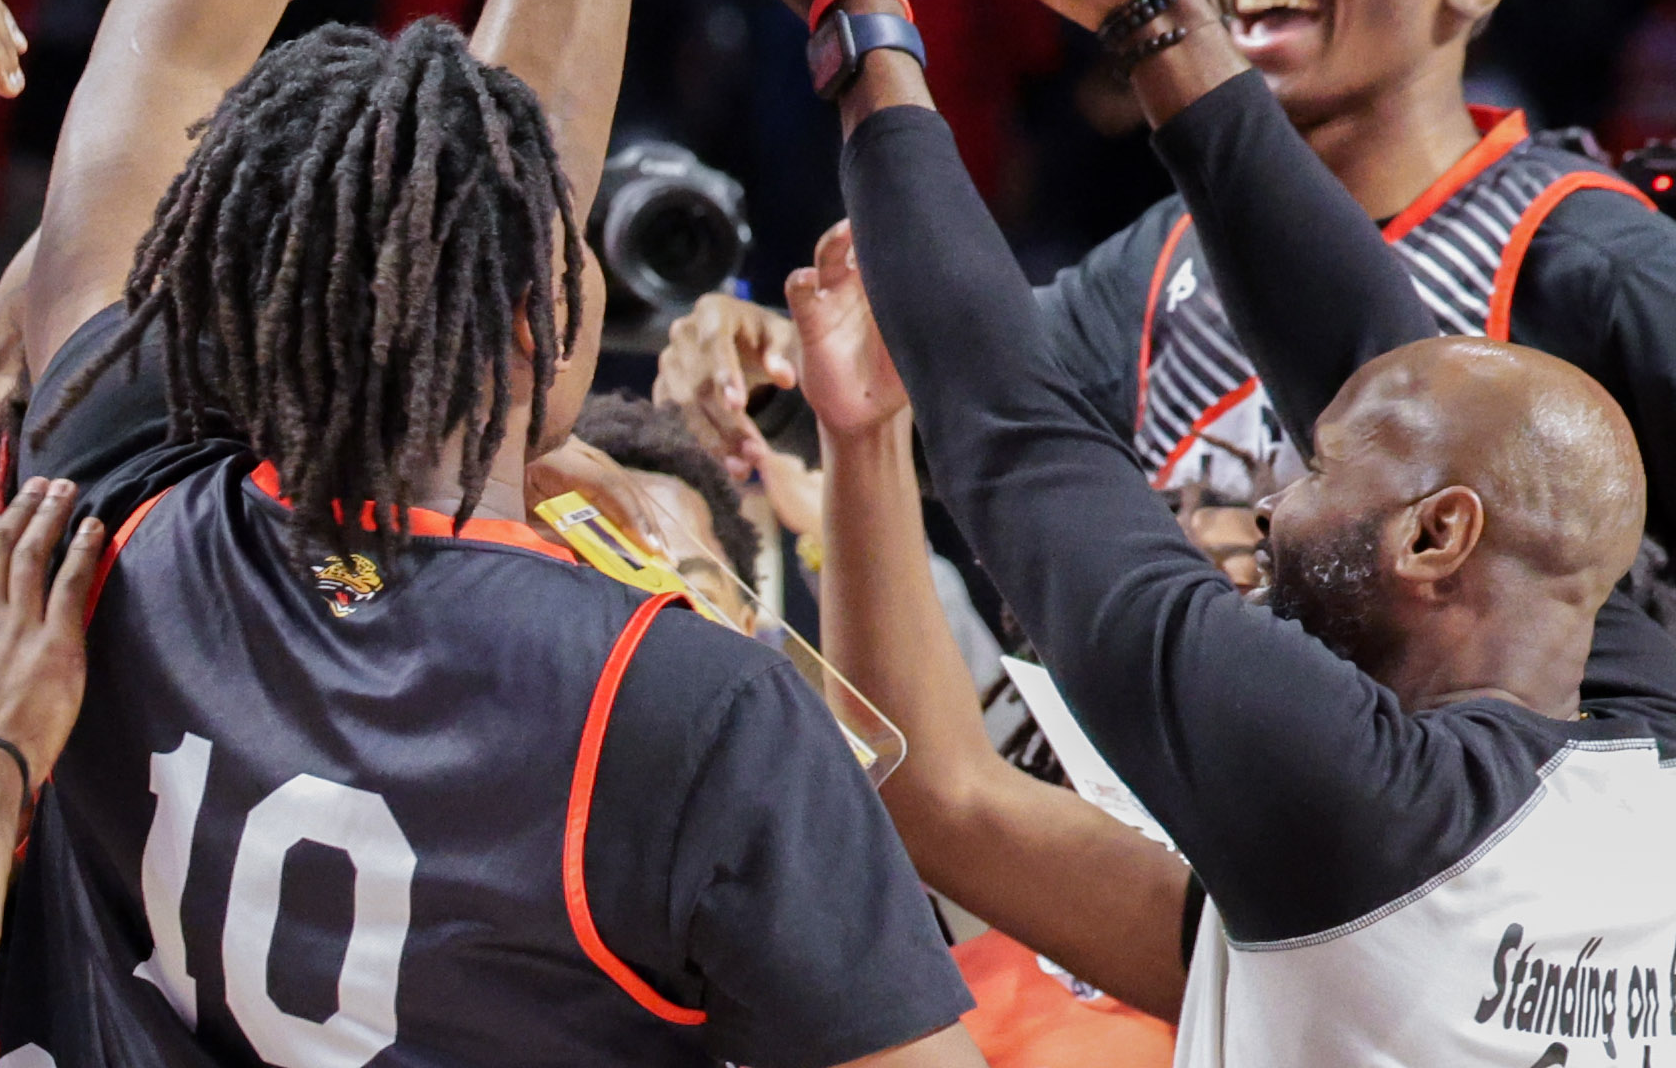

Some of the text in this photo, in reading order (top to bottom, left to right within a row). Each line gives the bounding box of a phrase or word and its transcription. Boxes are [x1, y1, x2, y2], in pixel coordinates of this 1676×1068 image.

[132, 731, 418, 1068] 10
[1474, 922, 1619, 1060] Standing
[1627, 964, 1660, 1039] on
